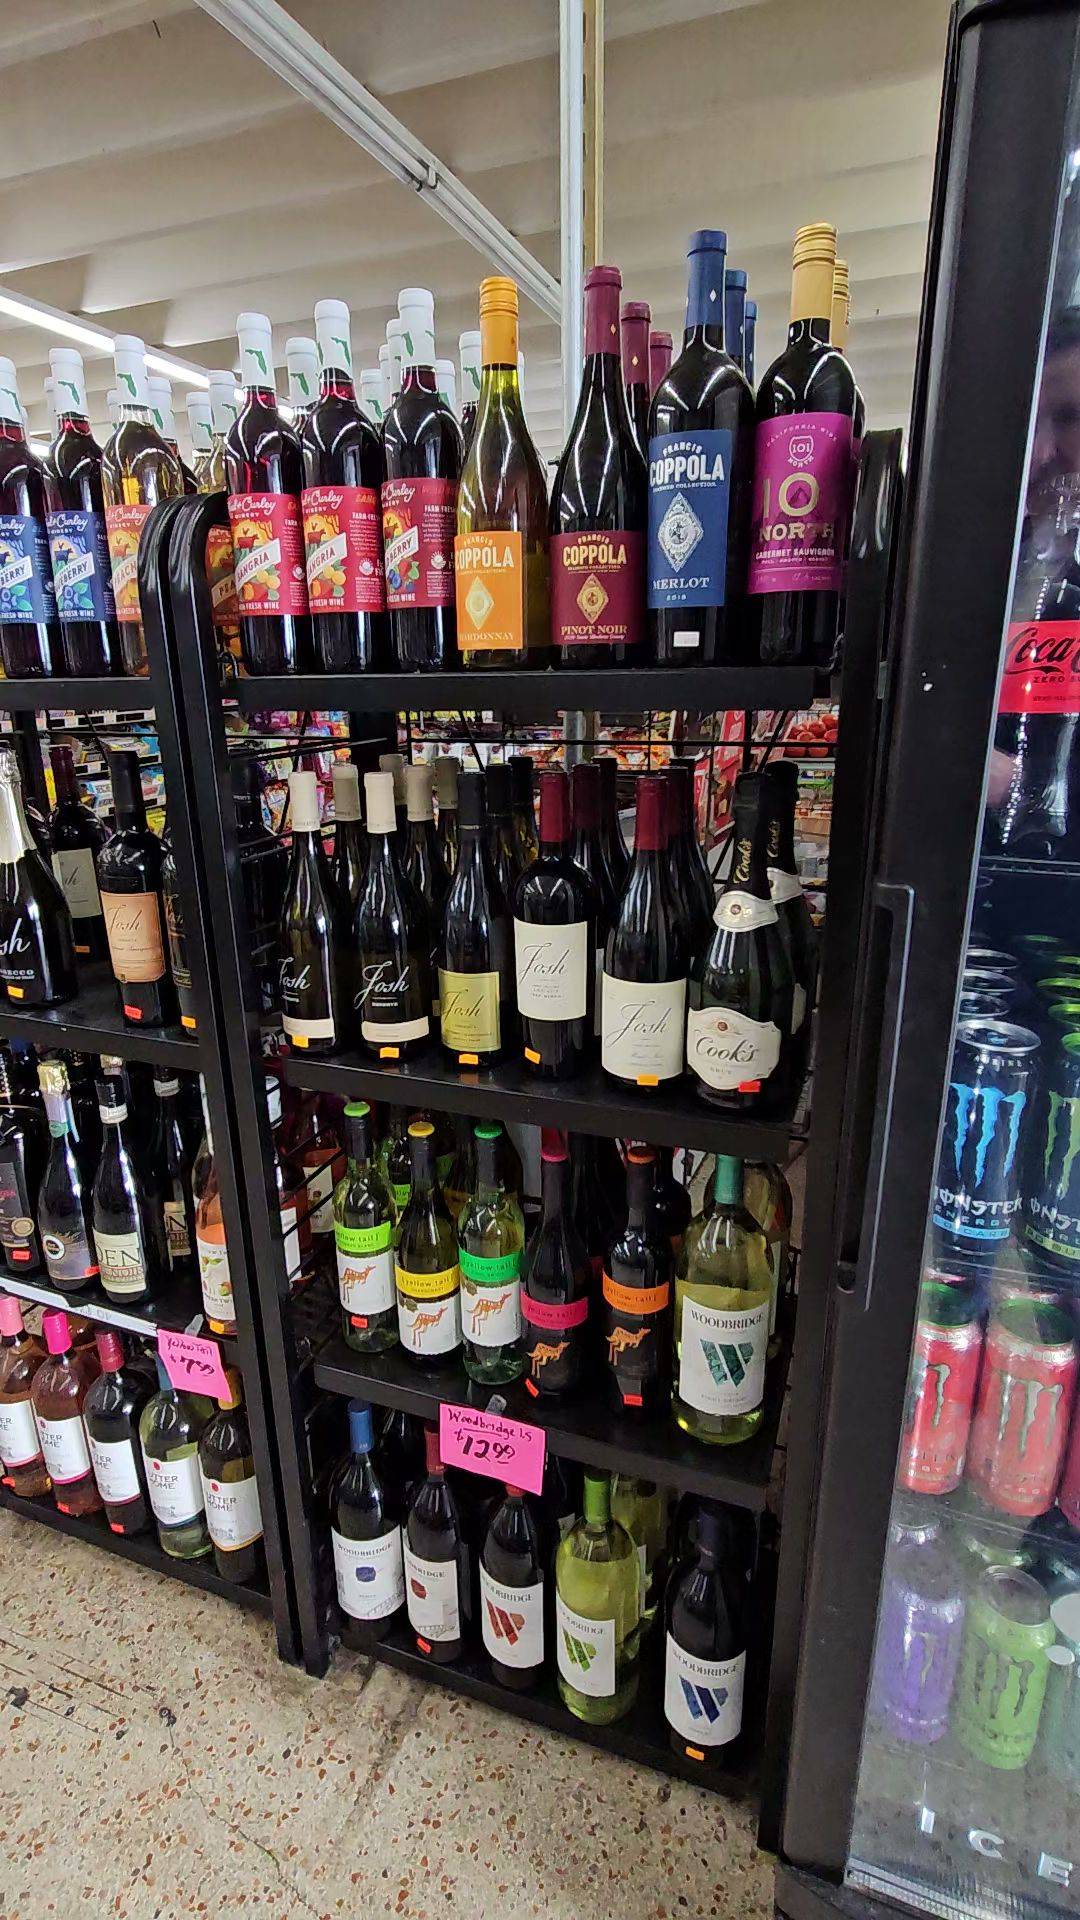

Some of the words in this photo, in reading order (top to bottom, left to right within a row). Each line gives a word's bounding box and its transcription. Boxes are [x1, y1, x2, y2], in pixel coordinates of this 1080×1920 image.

[662, 441, 703, 457] FRANCIS
[650, 453, 725, 487] COPPOLA
[236, 551, 270, 582] SANGRIA
[386, 539, 413, 567] BERRY
[456, 546, 515, 571] COPPOLA
[562, 543, 627, 567] COPPOLA
[652, 576, 710, 590] MERLOT
[561, 625, 595, 636] PINOT
[597, 625, 628, 635] NOIR
[0, 917, 31, 956] sh
[277, 956, 312, 990] Josh
[518, 942, 570, 986] Josh
[353, 960, 410, 1010] Josh
[438, 988, 485, 1023] Josh
[603, 1000, 672, 1049] Josh
[695, 1036, 760, 1063] Cook's
[690, 1309, 763, 1330] WOODBRIDGE
[448, 1408, 516, 1441] Woodbridge
